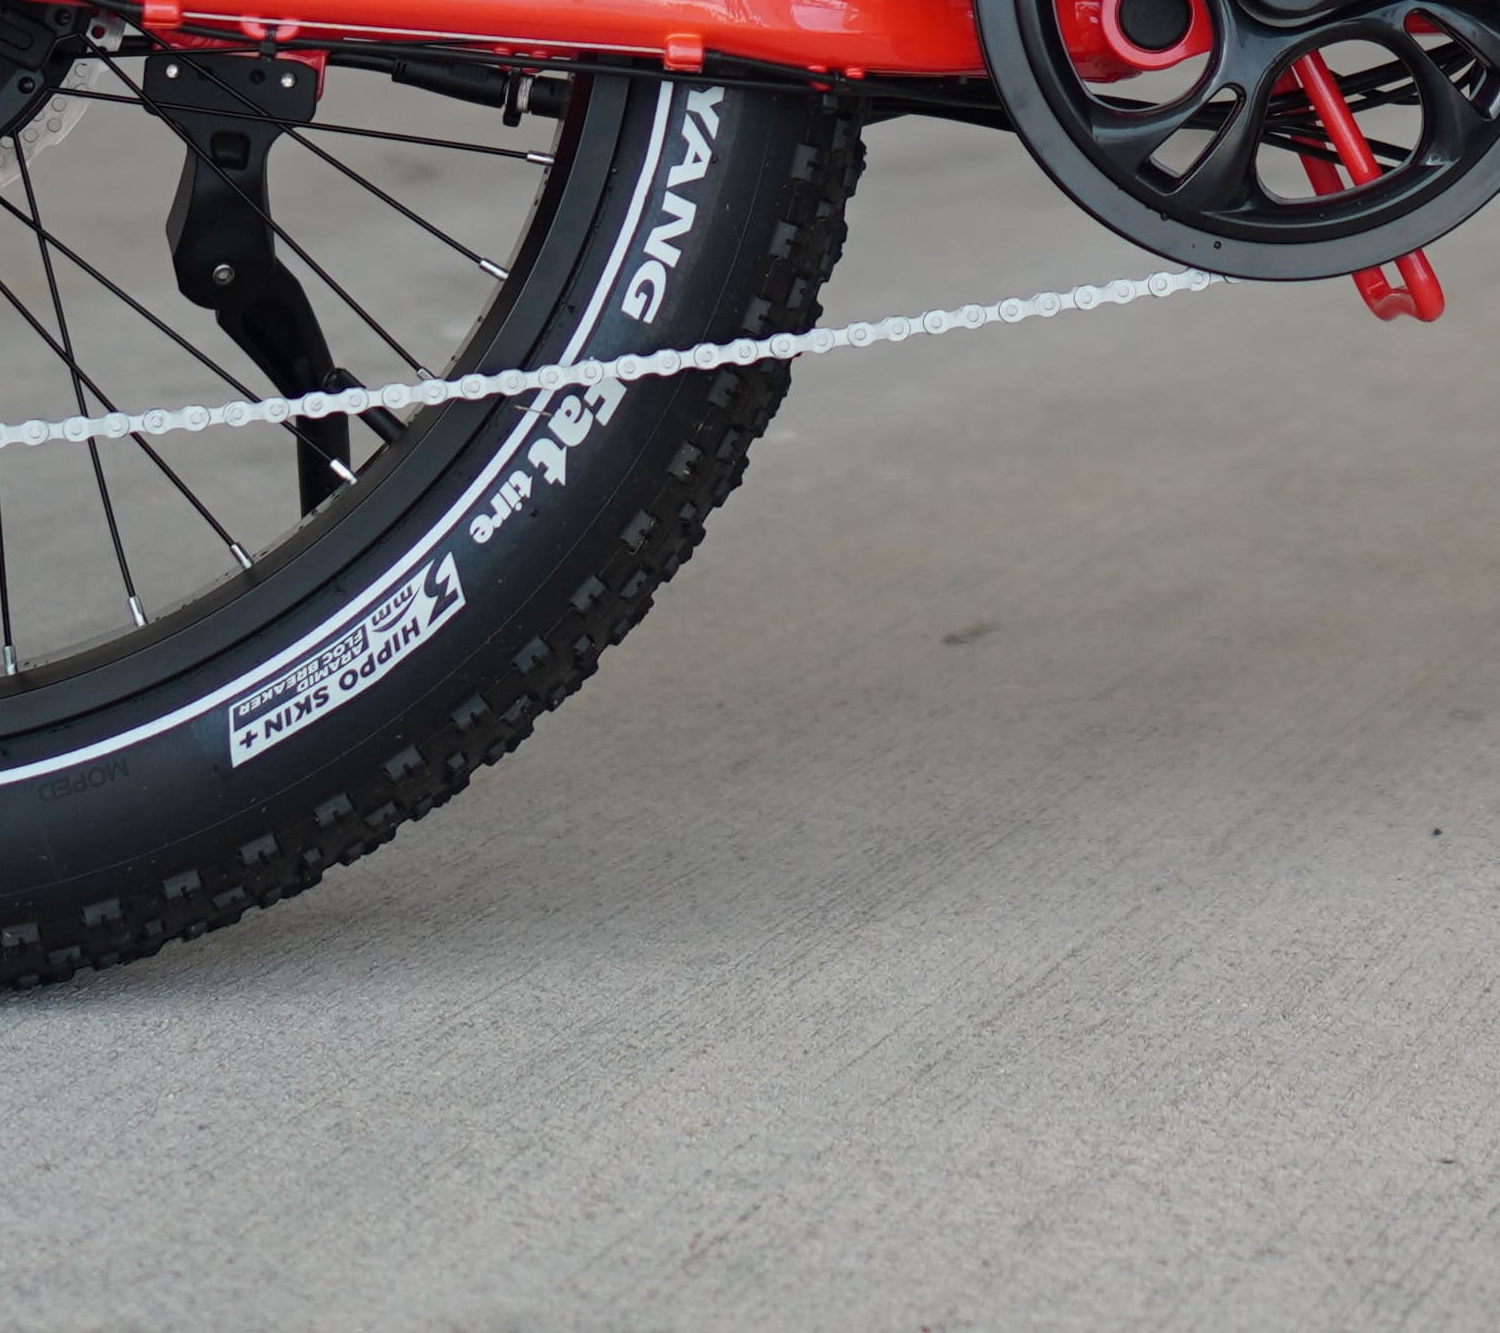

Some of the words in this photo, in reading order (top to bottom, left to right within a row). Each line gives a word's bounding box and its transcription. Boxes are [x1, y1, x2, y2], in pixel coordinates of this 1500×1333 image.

[621, 86, 725, 325] YANG
[469, 469, 533, 544] tire
[296, 645, 363, 693] ARAMID
[321, 632, 364, 664] FLOC
[338, 616, 421, 691] HIPPO
[238, 659, 322, 717] BREAKER
[264, 685, 330, 739] SKIN
[37, 756, 129, 805] MOPED
